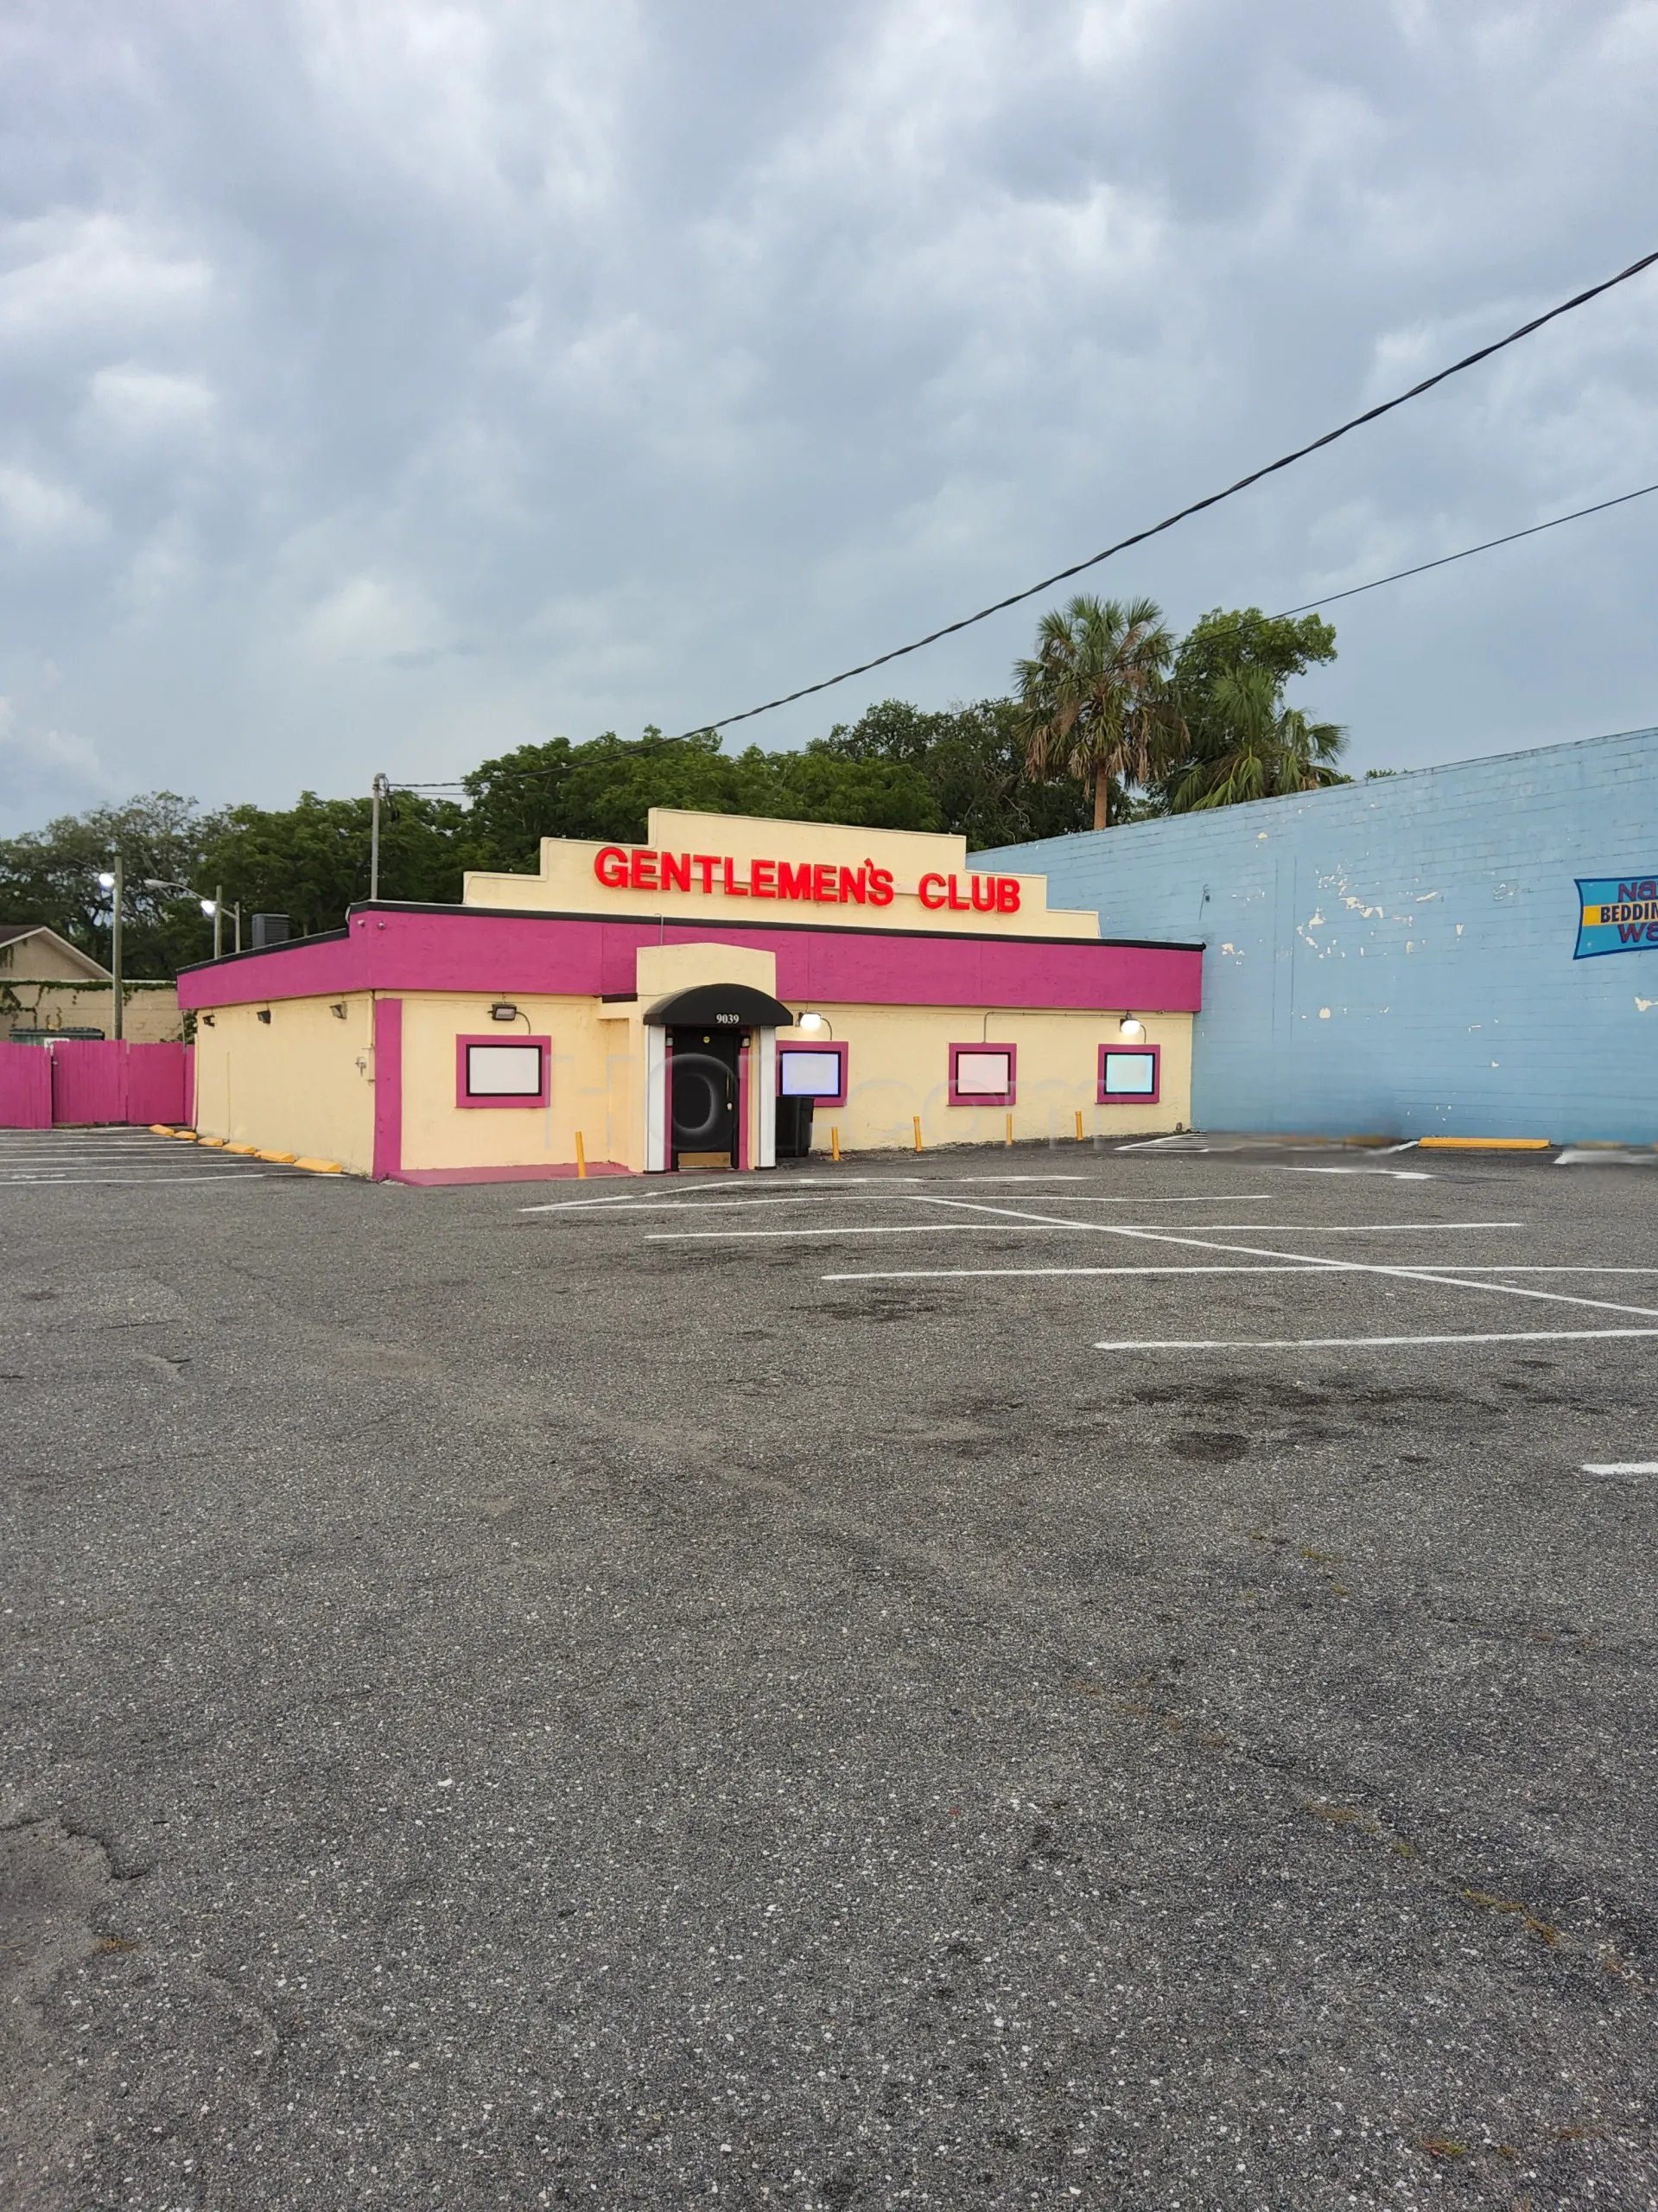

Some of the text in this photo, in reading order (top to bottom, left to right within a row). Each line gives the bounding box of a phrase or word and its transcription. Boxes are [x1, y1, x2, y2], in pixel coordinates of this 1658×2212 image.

[594, 847, 1020, 912] GENTLEMEN'S CLUB
[1617, 880, 1658, 904] Na
[715, 1014, 740, 1024] 9039
